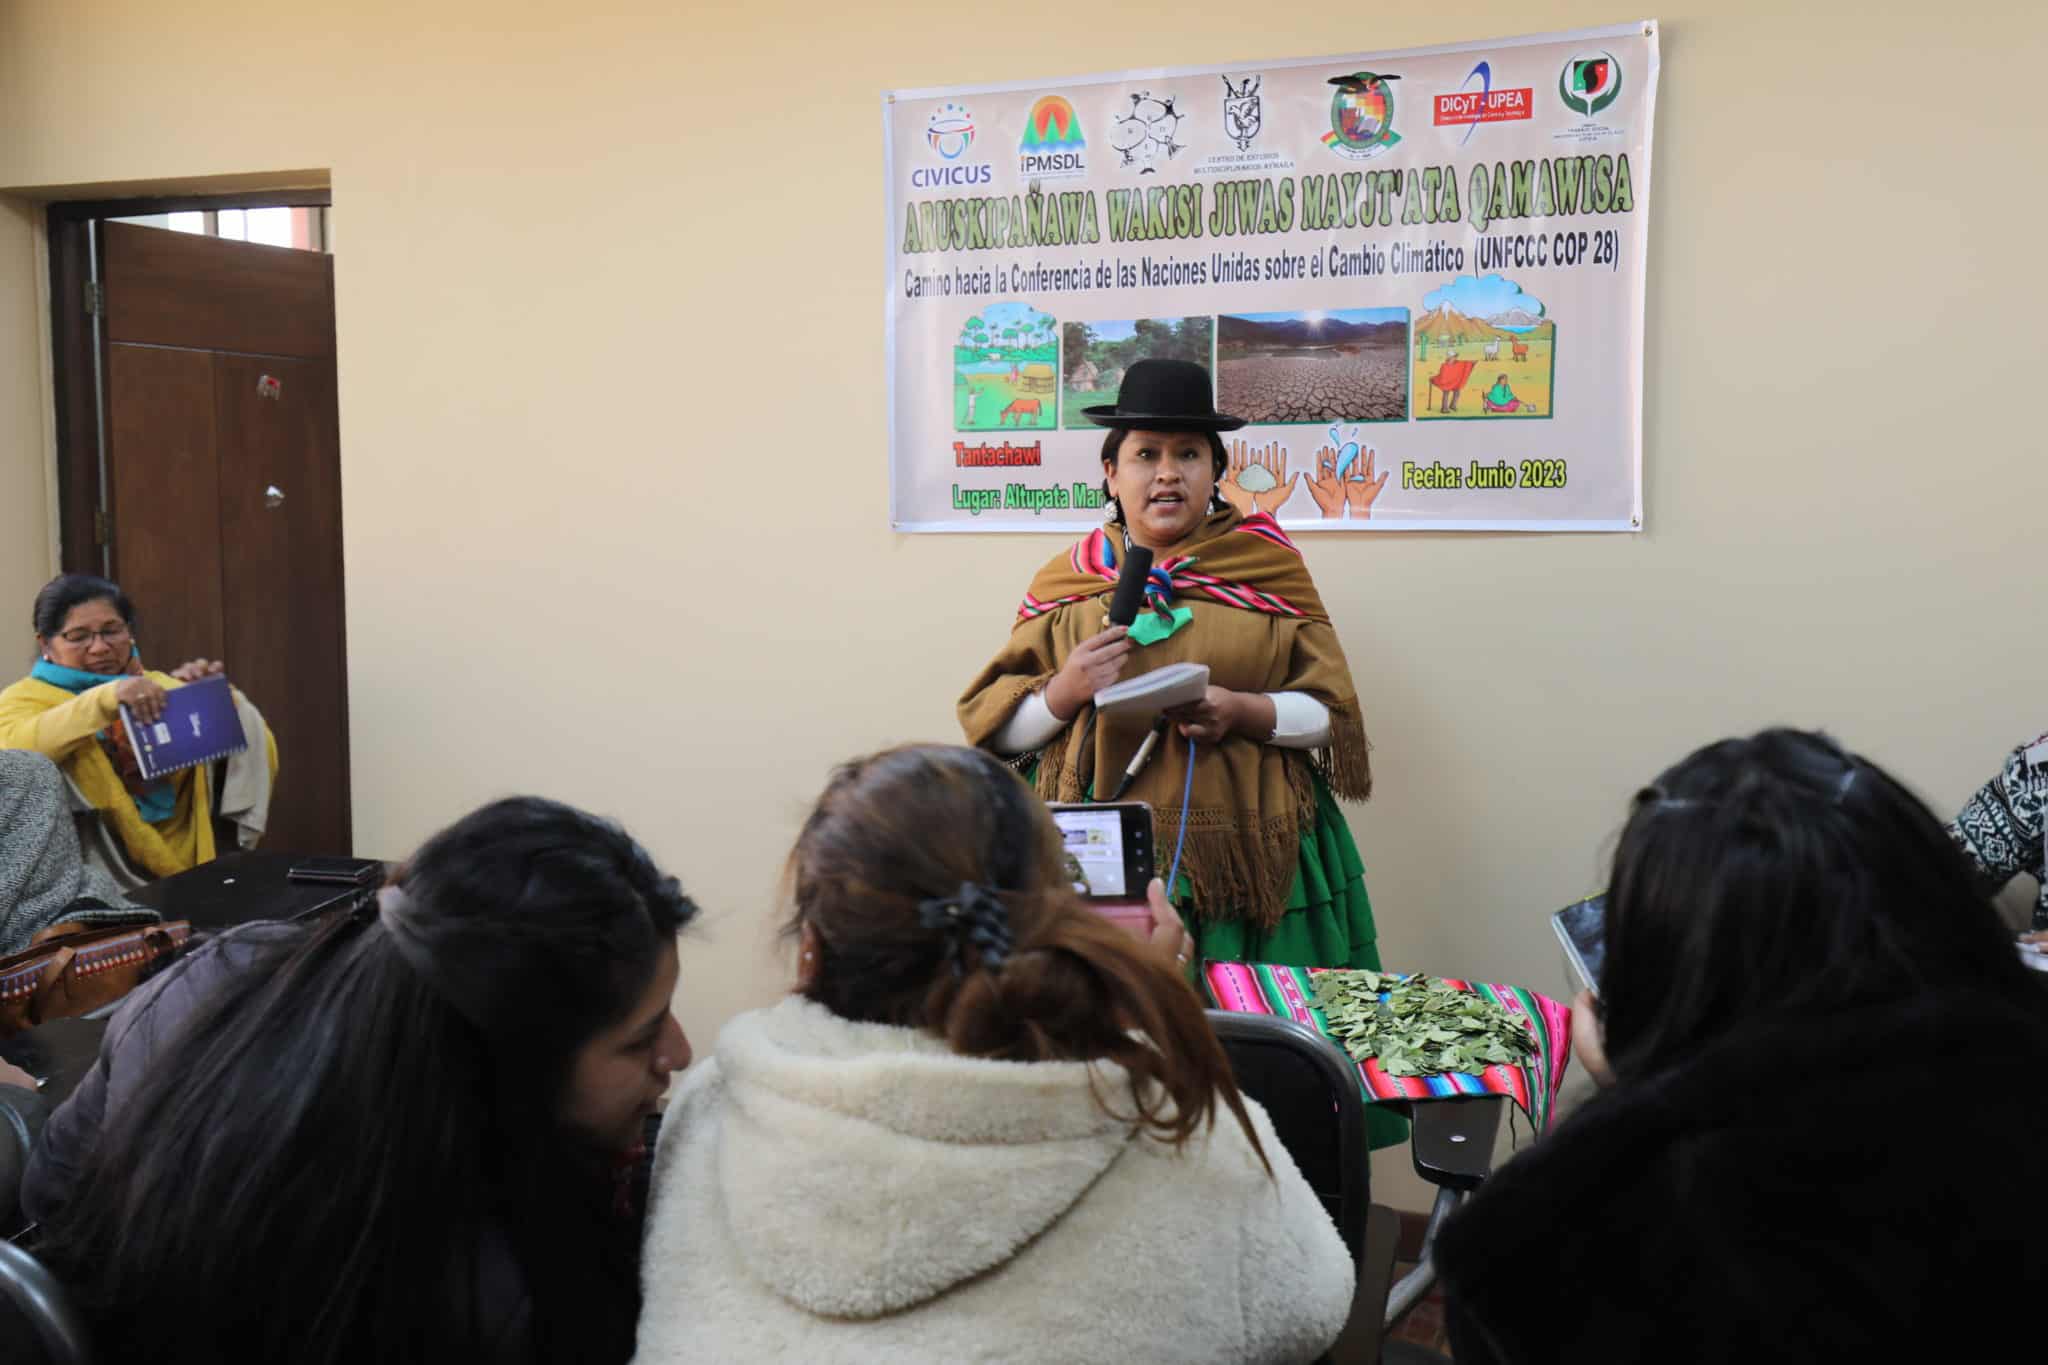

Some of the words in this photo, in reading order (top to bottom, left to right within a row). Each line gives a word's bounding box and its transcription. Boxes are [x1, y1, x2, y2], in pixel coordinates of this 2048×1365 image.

[1440, 96, 1477, 114] DICyT
[1488, 92, 1524, 109] UPEA
[912, 164, 992, 188] CIVICUS
[1020, 153, 1085, 172] iPMSDL
[1106, 183, 1204, 242] WAKISI
[1208, 177, 1295, 237] JIWAS
[1301, 165, 1461, 231] MAYJT'ATA
[1468, 153, 1634, 232] QAMAWISA
[904, 268, 950, 298] Camino
[956, 266, 991, 294] hacia
[996, 264, 1007, 293] la
[1011, 260, 1091, 292] Conferencia
[1096, 258, 1112, 288] de
[1116, 258, 1136, 288] las
[1142, 255, 1207, 287] Naciones
[1212, 251, 1260, 284] Unidas
[1264, 249, 1305, 281] sobre
[1310, 247, 1323, 278] el
[1329, 244, 1385, 278] Cambio
[1391, 240, 1464, 275] Climático
[1474, 233, 1548, 279] (UNFCCC
[1553, 232, 1588, 266] COP
[1593, 230, 1619, 272] 28)
[953, 440, 1041, 467] Tantachawi
[1402, 461, 1462, 489] Fecha:
[1466, 459, 1517, 489] Junio
[1520, 458, 1568, 488] 2023
[952, 483, 1001, 515] Lugar:
[1004, 482, 1070, 515] Altupata
